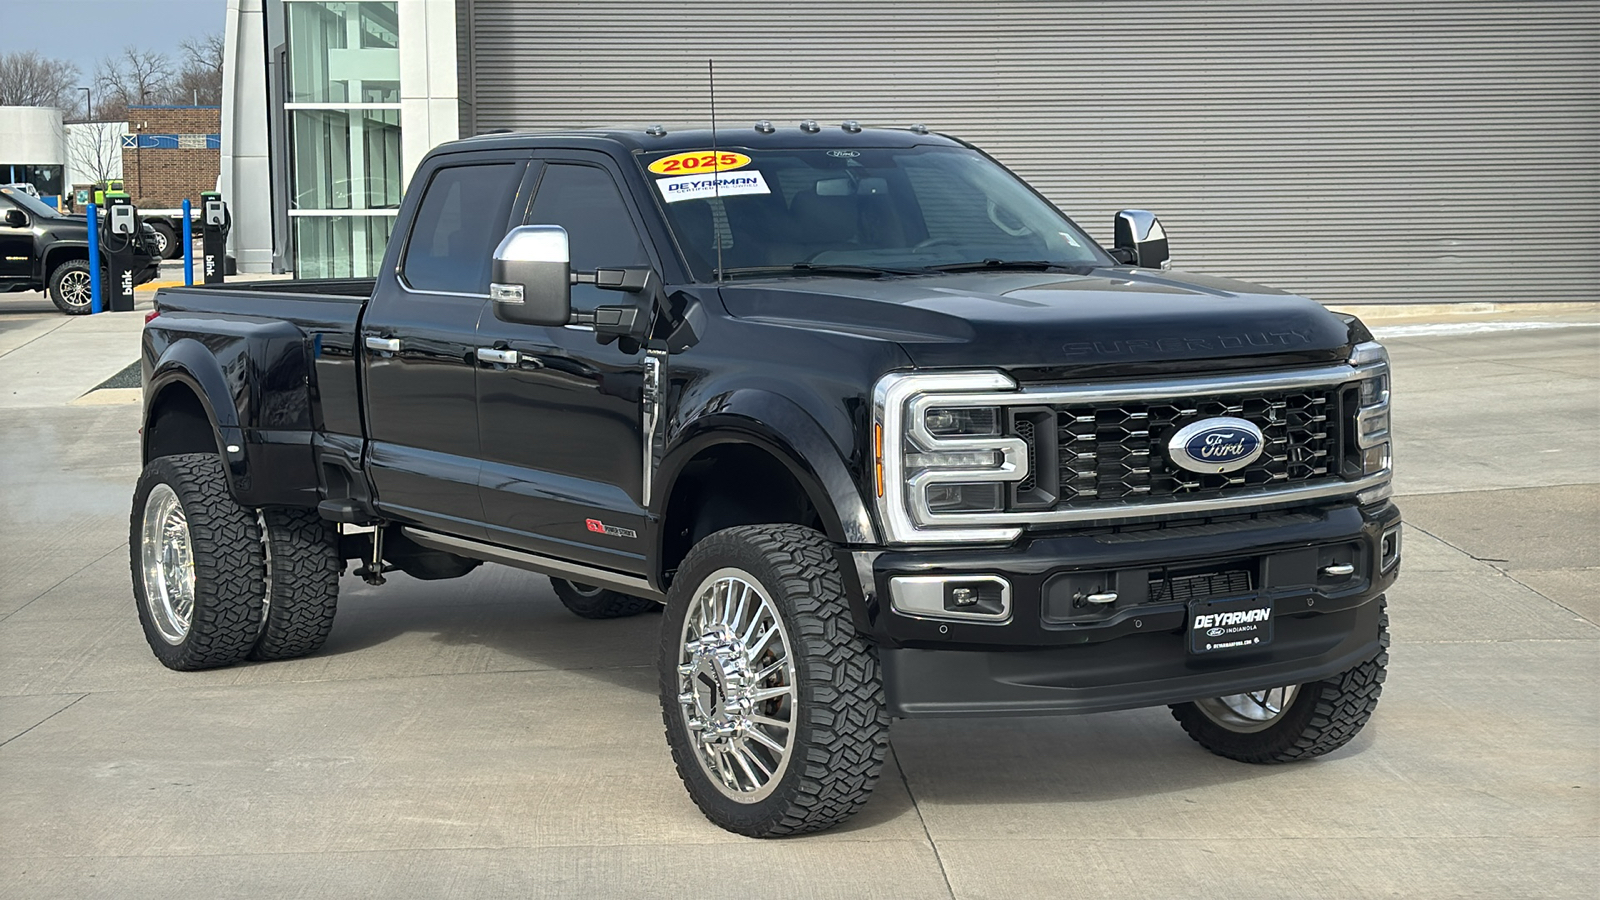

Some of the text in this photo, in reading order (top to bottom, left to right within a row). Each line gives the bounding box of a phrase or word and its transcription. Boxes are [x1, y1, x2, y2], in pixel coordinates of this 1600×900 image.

[662, 155, 738, 172] 2025
[668, 177, 757, 192] DEYARMAN
[205, 255, 216, 276] blink
[122, 269, 133, 295] blink
[1062, 329, 1313, 356] SUPER DUTY
[1201, 432, 1245, 457] Ford
[1194, 608, 1271, 629] DEYARMAN
[1226, 625, 1257, 633] INDIANOLA
